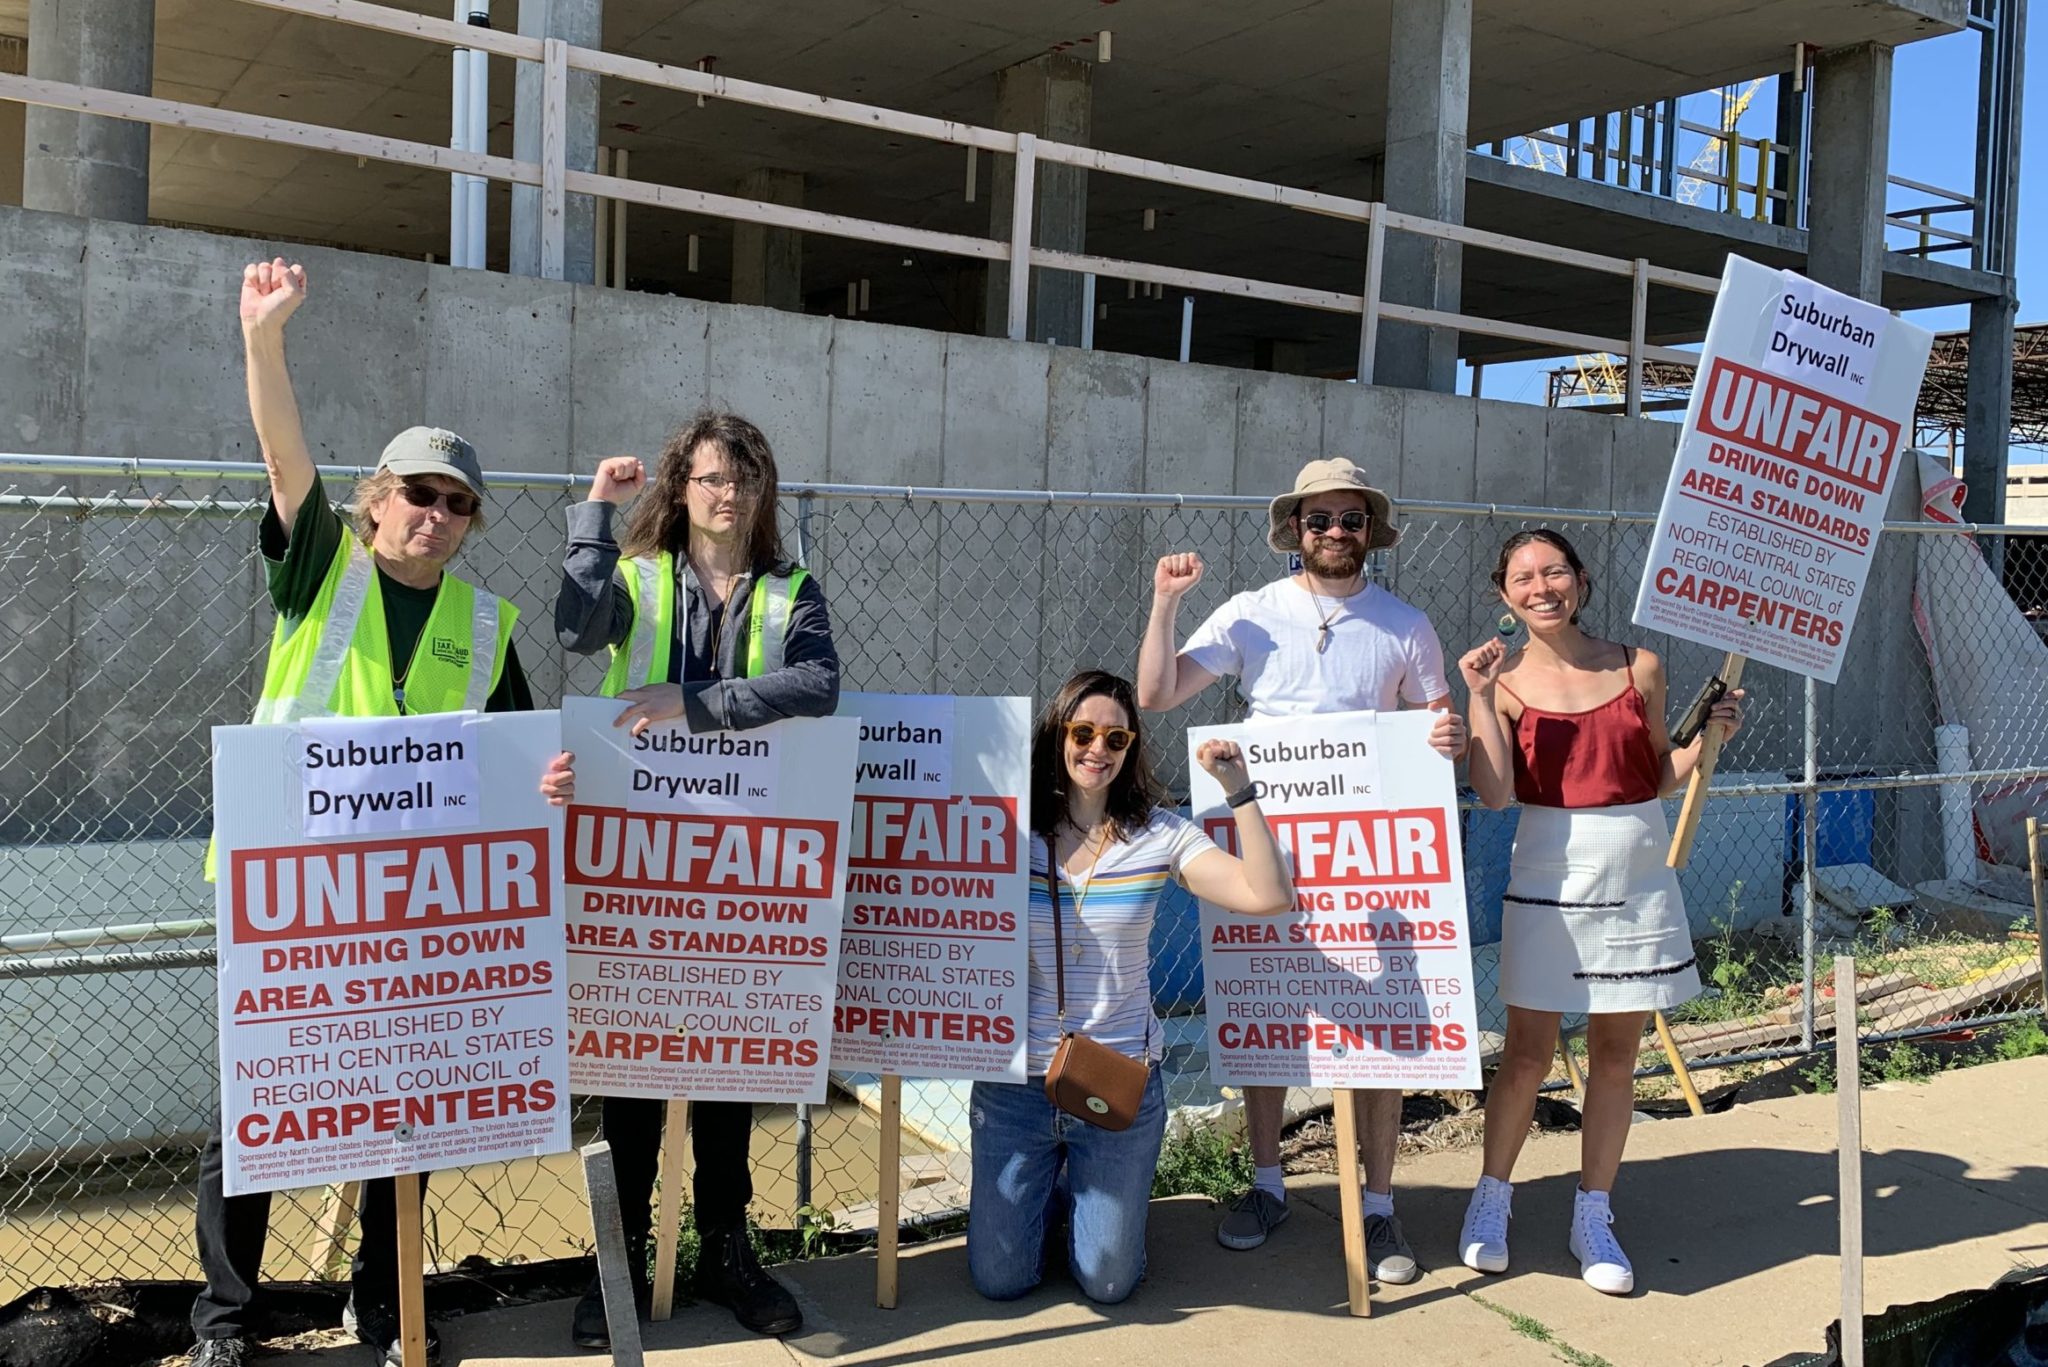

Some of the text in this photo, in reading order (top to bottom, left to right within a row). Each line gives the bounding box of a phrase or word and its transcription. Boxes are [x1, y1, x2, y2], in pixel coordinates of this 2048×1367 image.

[1780, 294, 1874, 348] Suburban
[1770, 330, 1864, 385] Drywall INC
[1710, 369, 1889, 485] UNFAIR
[1708, 443, 1865, 512] DRIVING DOWN
[1680, 468, 1869, 547] AREA STANDARDS
[1705, 509, 1838, 564] ESTABLISHED BY
[1667, 521, 1856, 597] NORTH CENTRAL STATES
[1669, 547, 1844, 615] REGIONAL COUNCIL of
[1655, 567, 1844, 646] CARPENTERS
[634, 728, 769, 757] Suburban
[859, 720, 942, 744] burban
[306, 736, 463, 768] Suburban
[1248, 738, 1366, 764] Suburban
[632, 768, 768, 798] Drywall INC
[855, 758, 941, 783] ywall INC
[308, 781, 466, 820] Drywall INC
[1352, 784, 1371, 794] INC
[849, 799, 1005, 864] FAIR
[1212, 817, 1440, 878] FAIR
[575, 815, 824, 888] UNFAIR
[245, 840, 537, 930] UNFAIR
[844, 872, 994, 898] VING DOWN
[1344, 889, 1430, 911] DOWN
[582, 891, 808, 923] DRIVING DOWN
[853, 904, 1016, 932] STANDARDS
[649, 928, 827, 957] STANDARDS
[1212, 920, 1456, 944] AREA STANDARDS
[262, 926, 525, 973] DRIVING DOWN
[839, 937, 977, 964] TABLISHED BY
[1249, 952, 1419, 975] ESTABLISHED BY
[235, 960, 552, 1014] AREA STANDARDS
[597, 959, 783, 988] ESTABLISHED BY
[843, 959, 934, 983] CENTRAL
[940, 964, 1015, 989] STATES
[1213, 976, 1461, 997] NORTH CENTRAL STATES
[567, 981, 822, 1012] ORTH CENTRAL STATES
[835, 983, 1005, 1013] ONAL COUNCIL of
[1226, 999, 1452, 1021] REGIONAL COUNCIL of
[287, 1007, 504, 1049] ESTABLISHED BY
[682, 1010, 784, 1035] COUNCIL
[786, 1016, 811, 1036] of
[833, 1005, 1014, 1044] RPENTERS
[1218, 1023, 1466, 1051] CARPENTERS
[235, 1025, 556, 1080] NORTH CENTRAL STATES
[568, 1031, 817, 1067] ARPENTERS
[1219, 1052, 1246, 1060] Sponsored
[251, 1055, 542, 1106] REGIONAL COUNCIL of
[579, 1061, 588, 1069] by
[649, 1065, 676, 1073] Regional
[707, 1067, 740, 1076] Carpenters.
[793, 1071, 816, 1079] dispute
[237, 1080, 555, 1147] CARPENTERS
[238, 1150, 277, 1164] Sponsored
[278, 1149, 288, 1159] by
[289, 1146, 309, 1156] North
[311, 1143, 336, 1153] Central
[338, 1140, 361, 1150] States
[362, 1136, 393, 1148] Regional
[422, 1131, 430, 1139] of
[431, 1126, 469, 1140] Carpenters.
[471, 1124, 484, 1133] The
[485, 1121, 505, 1131] Union
[506, 1120, 519, 1128] has
[530, 1115, 555, 1127] dispute
[240, 1163, 256, 1172] with
[258, 1161, 285, 1172] anyone
[286, 1157, 304, 1167] other
[307, 1155, 323, 1164] than
[325, 1153, 337, 1162] the
[338, 1150, 362, 1160] named
[364, 1145, 399, 1159] Company,
[400, 1144, 414, 1152] and
[441, 1139, 452, 1147] not
[453, 1135, 476, 1147] asking
[477, 1135, 490, 1144] any
[491, 1129, 524, 1140] individual
[524, 1128, 532, 1136] to
[533, 1127, 553, 1135] cease
[249, 1169, 290, 1183] performing
[291, 1168, 305, 1178] any
[306, 1163, 338, 1176] services,
[349, 1161, 356, 1169] to
[358, 1157, 381, 1168] refuse
[382, 1156, 389, 1164] to
[391, 1153, 416, 1165] pickup,
[417, 1150, 443, 1161] deliver,
[444, 1146, 467, 1156] handle
[477, 1141, 508, 1153] transport
[509, 1140, 521, 1149] any
[522, 1136, 544, 1147] goods.
